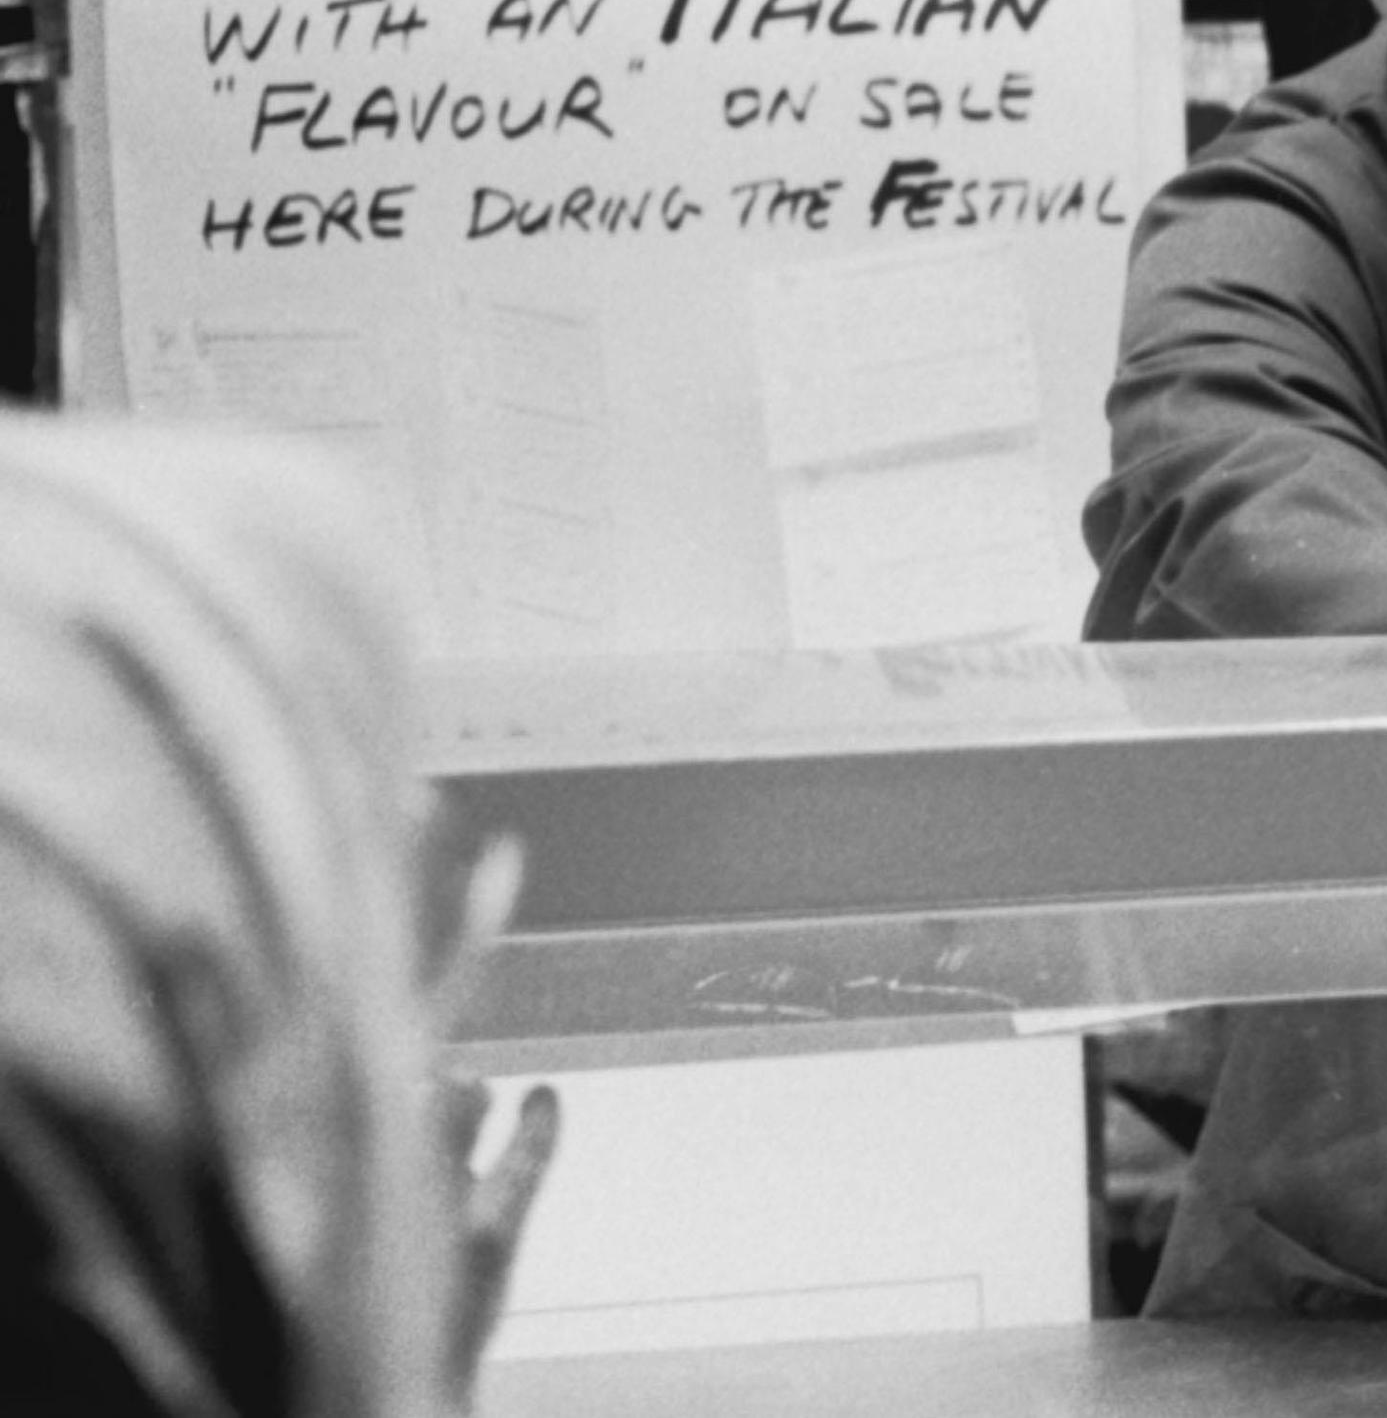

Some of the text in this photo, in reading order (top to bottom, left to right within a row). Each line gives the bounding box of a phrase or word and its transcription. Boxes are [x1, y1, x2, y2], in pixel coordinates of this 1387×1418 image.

[722, 85, 816, 130] ON
[858, 70, 1036, 132] SALE
[200, 156, 1129, 252] HERE DURING THE FESTIVAL
